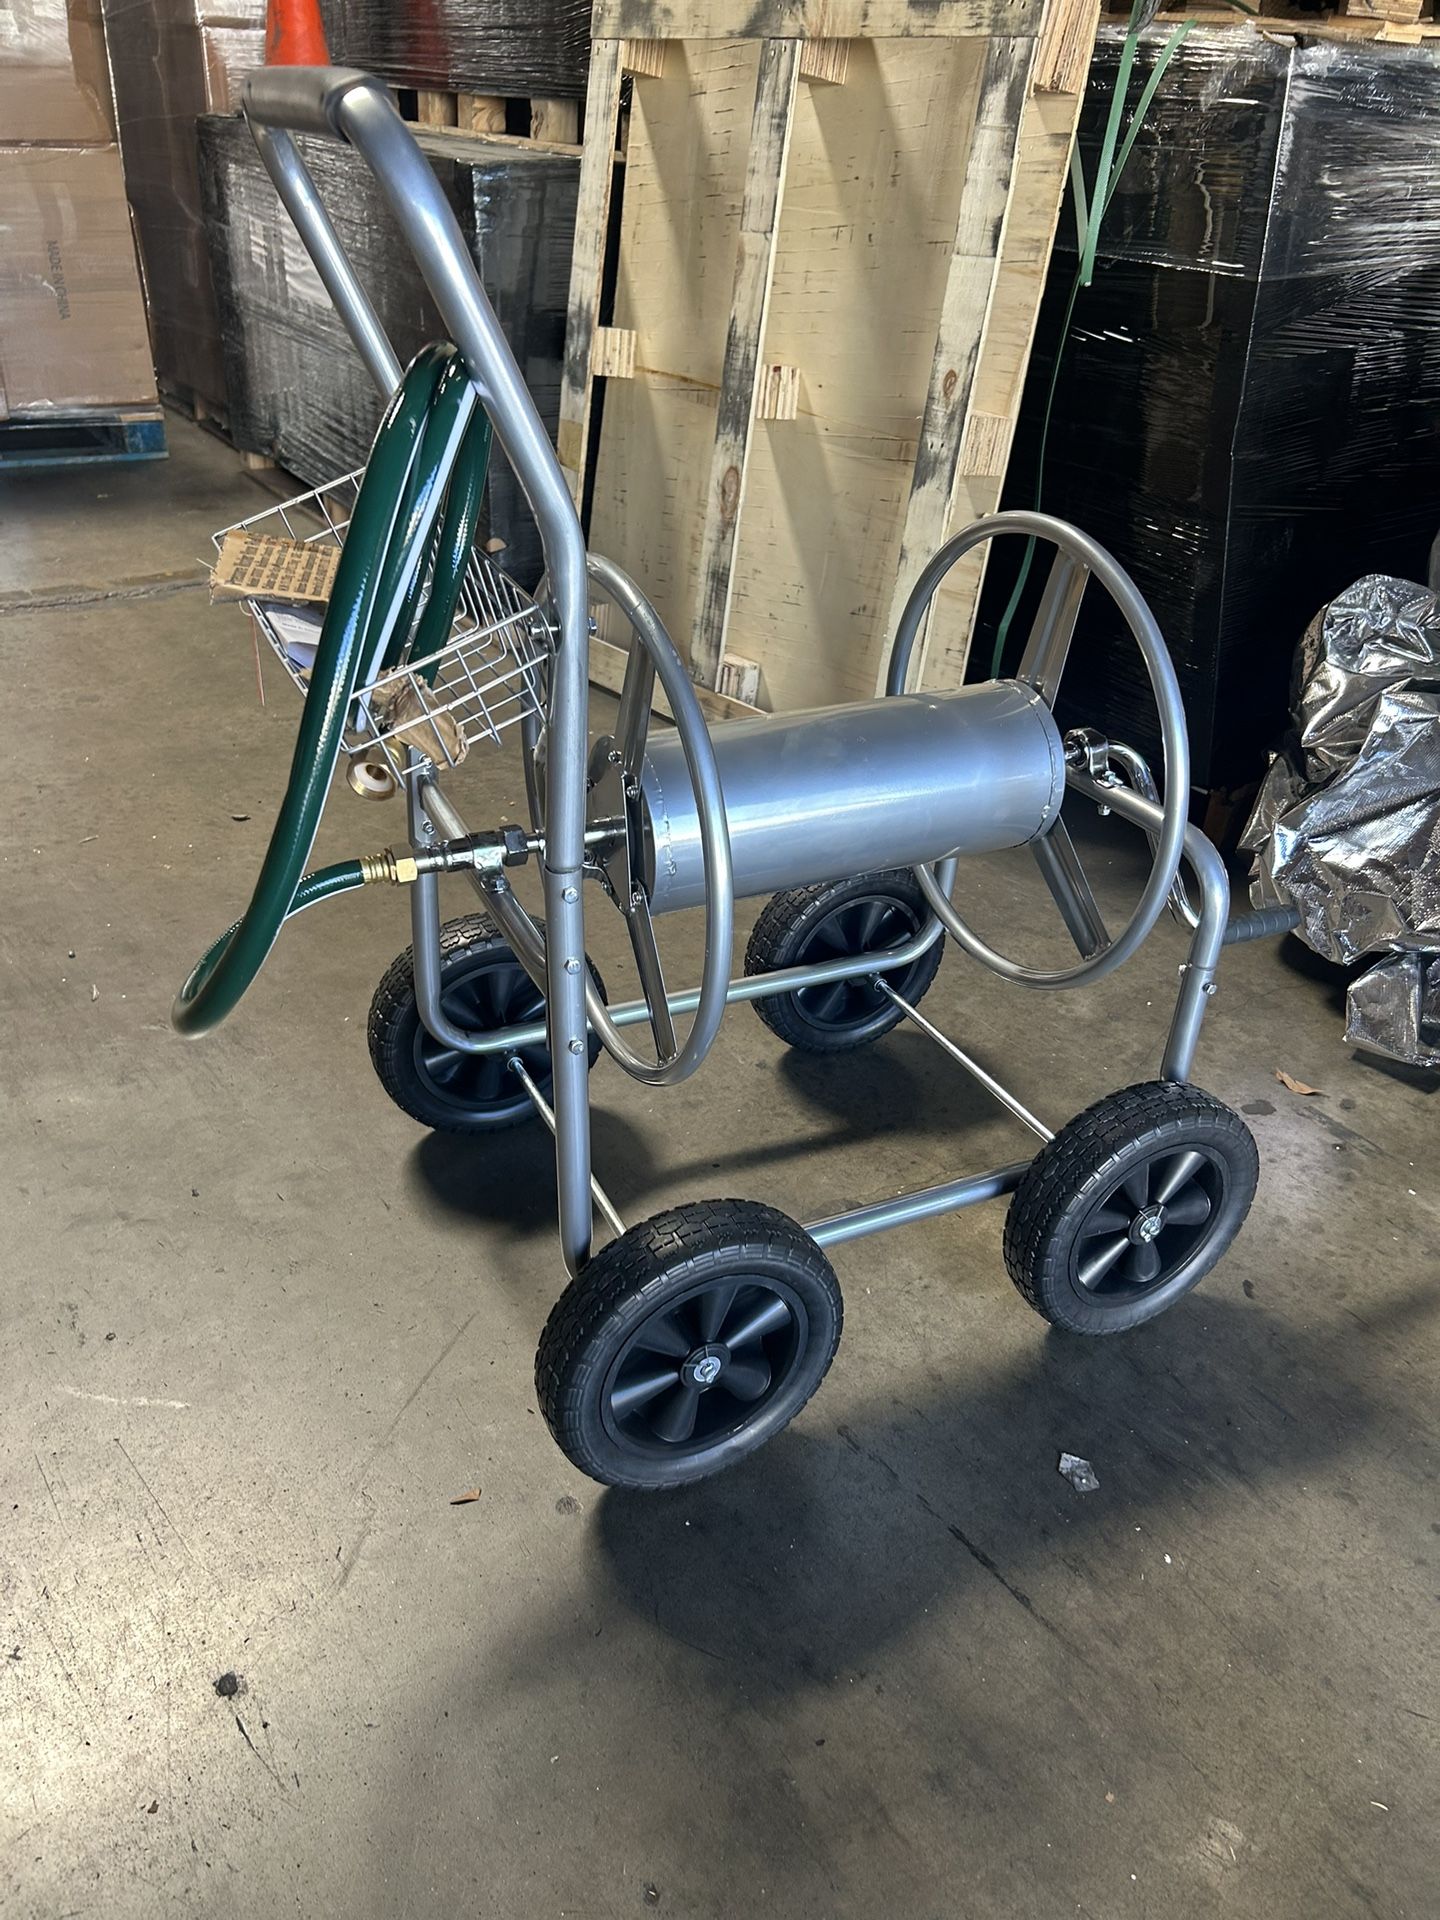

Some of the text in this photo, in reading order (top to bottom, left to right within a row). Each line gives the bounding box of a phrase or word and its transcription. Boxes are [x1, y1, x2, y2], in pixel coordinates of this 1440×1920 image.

[47, 240, 71, 320] MADE IN CHINA
